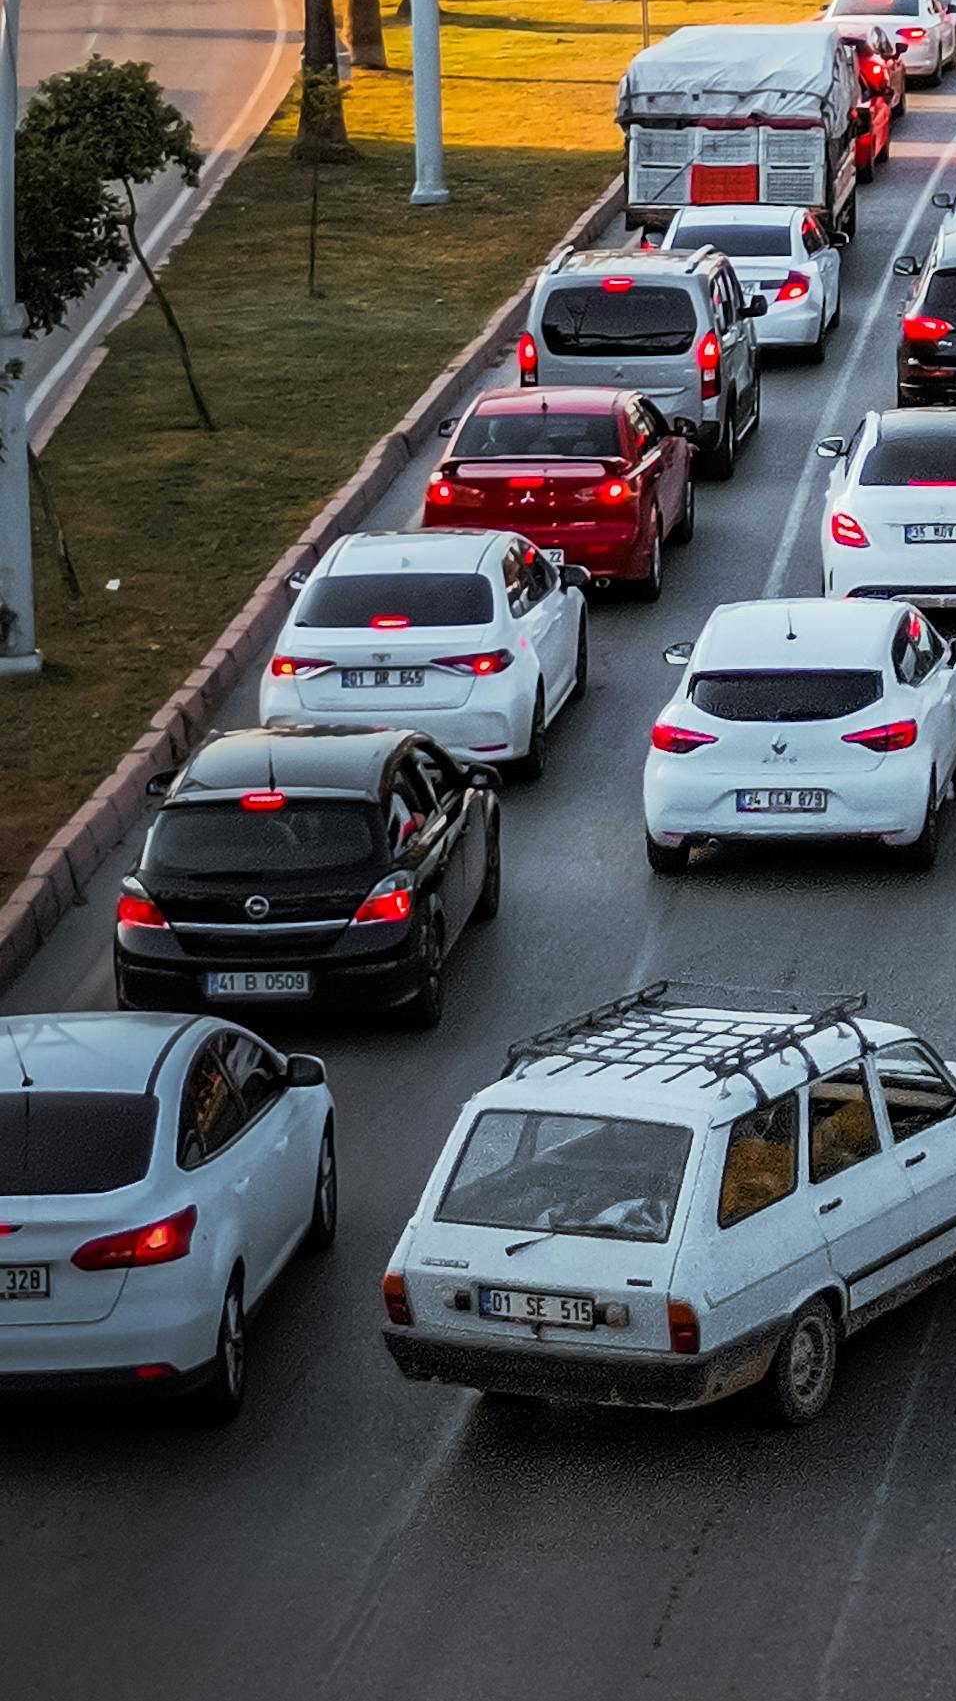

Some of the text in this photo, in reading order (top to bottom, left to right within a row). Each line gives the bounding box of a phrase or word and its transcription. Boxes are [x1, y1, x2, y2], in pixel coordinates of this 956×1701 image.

[350, 671, 364, 686] 01
[219, 973, 305, 991] 41 B 0509
[6, 1269, 41, 1290] 328
[492, 1292, 592, 1322] 01 SE 515
